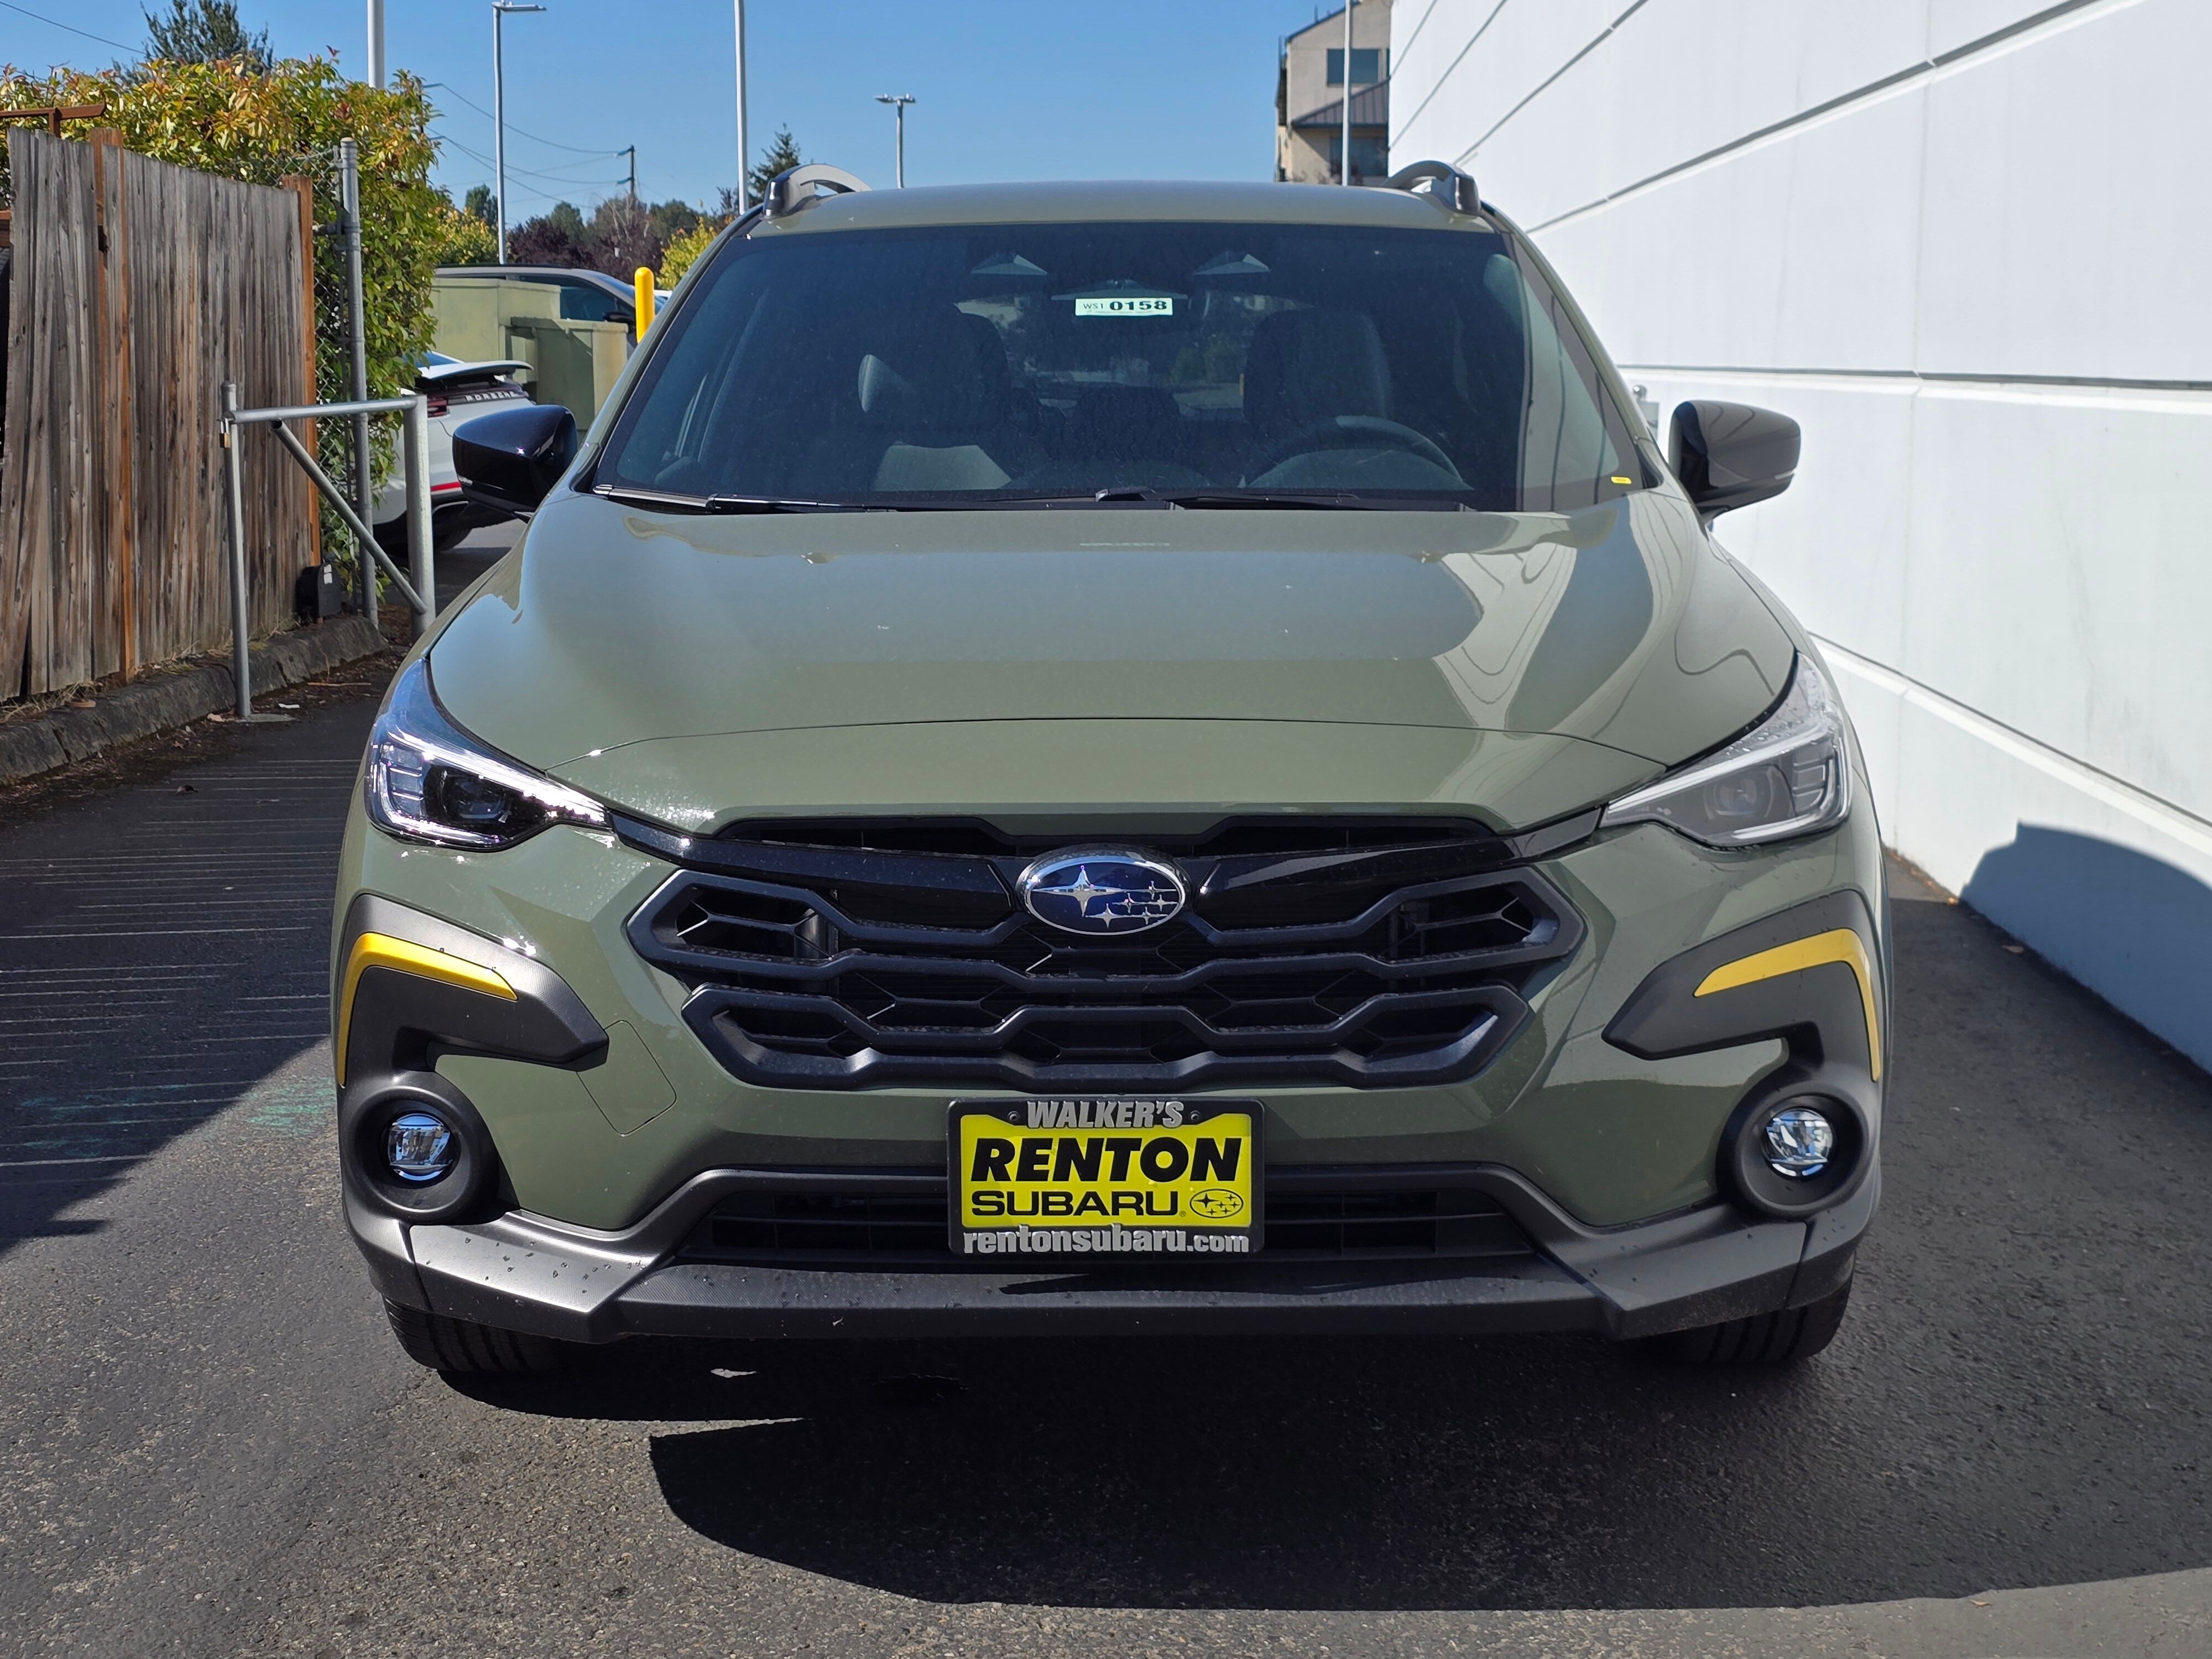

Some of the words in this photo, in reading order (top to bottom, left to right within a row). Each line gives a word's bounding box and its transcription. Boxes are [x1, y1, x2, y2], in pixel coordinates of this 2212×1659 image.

[1109, 300, 1167, 311] 0158
[1027, 1100, 1185, 1129] WALKER'S
[971, 1136, 1242, 1183] RENTON
[971, 1190, 1179, 1217] SUBARU
[963, 1223, 1249, 1254] rentonsubaru.com
